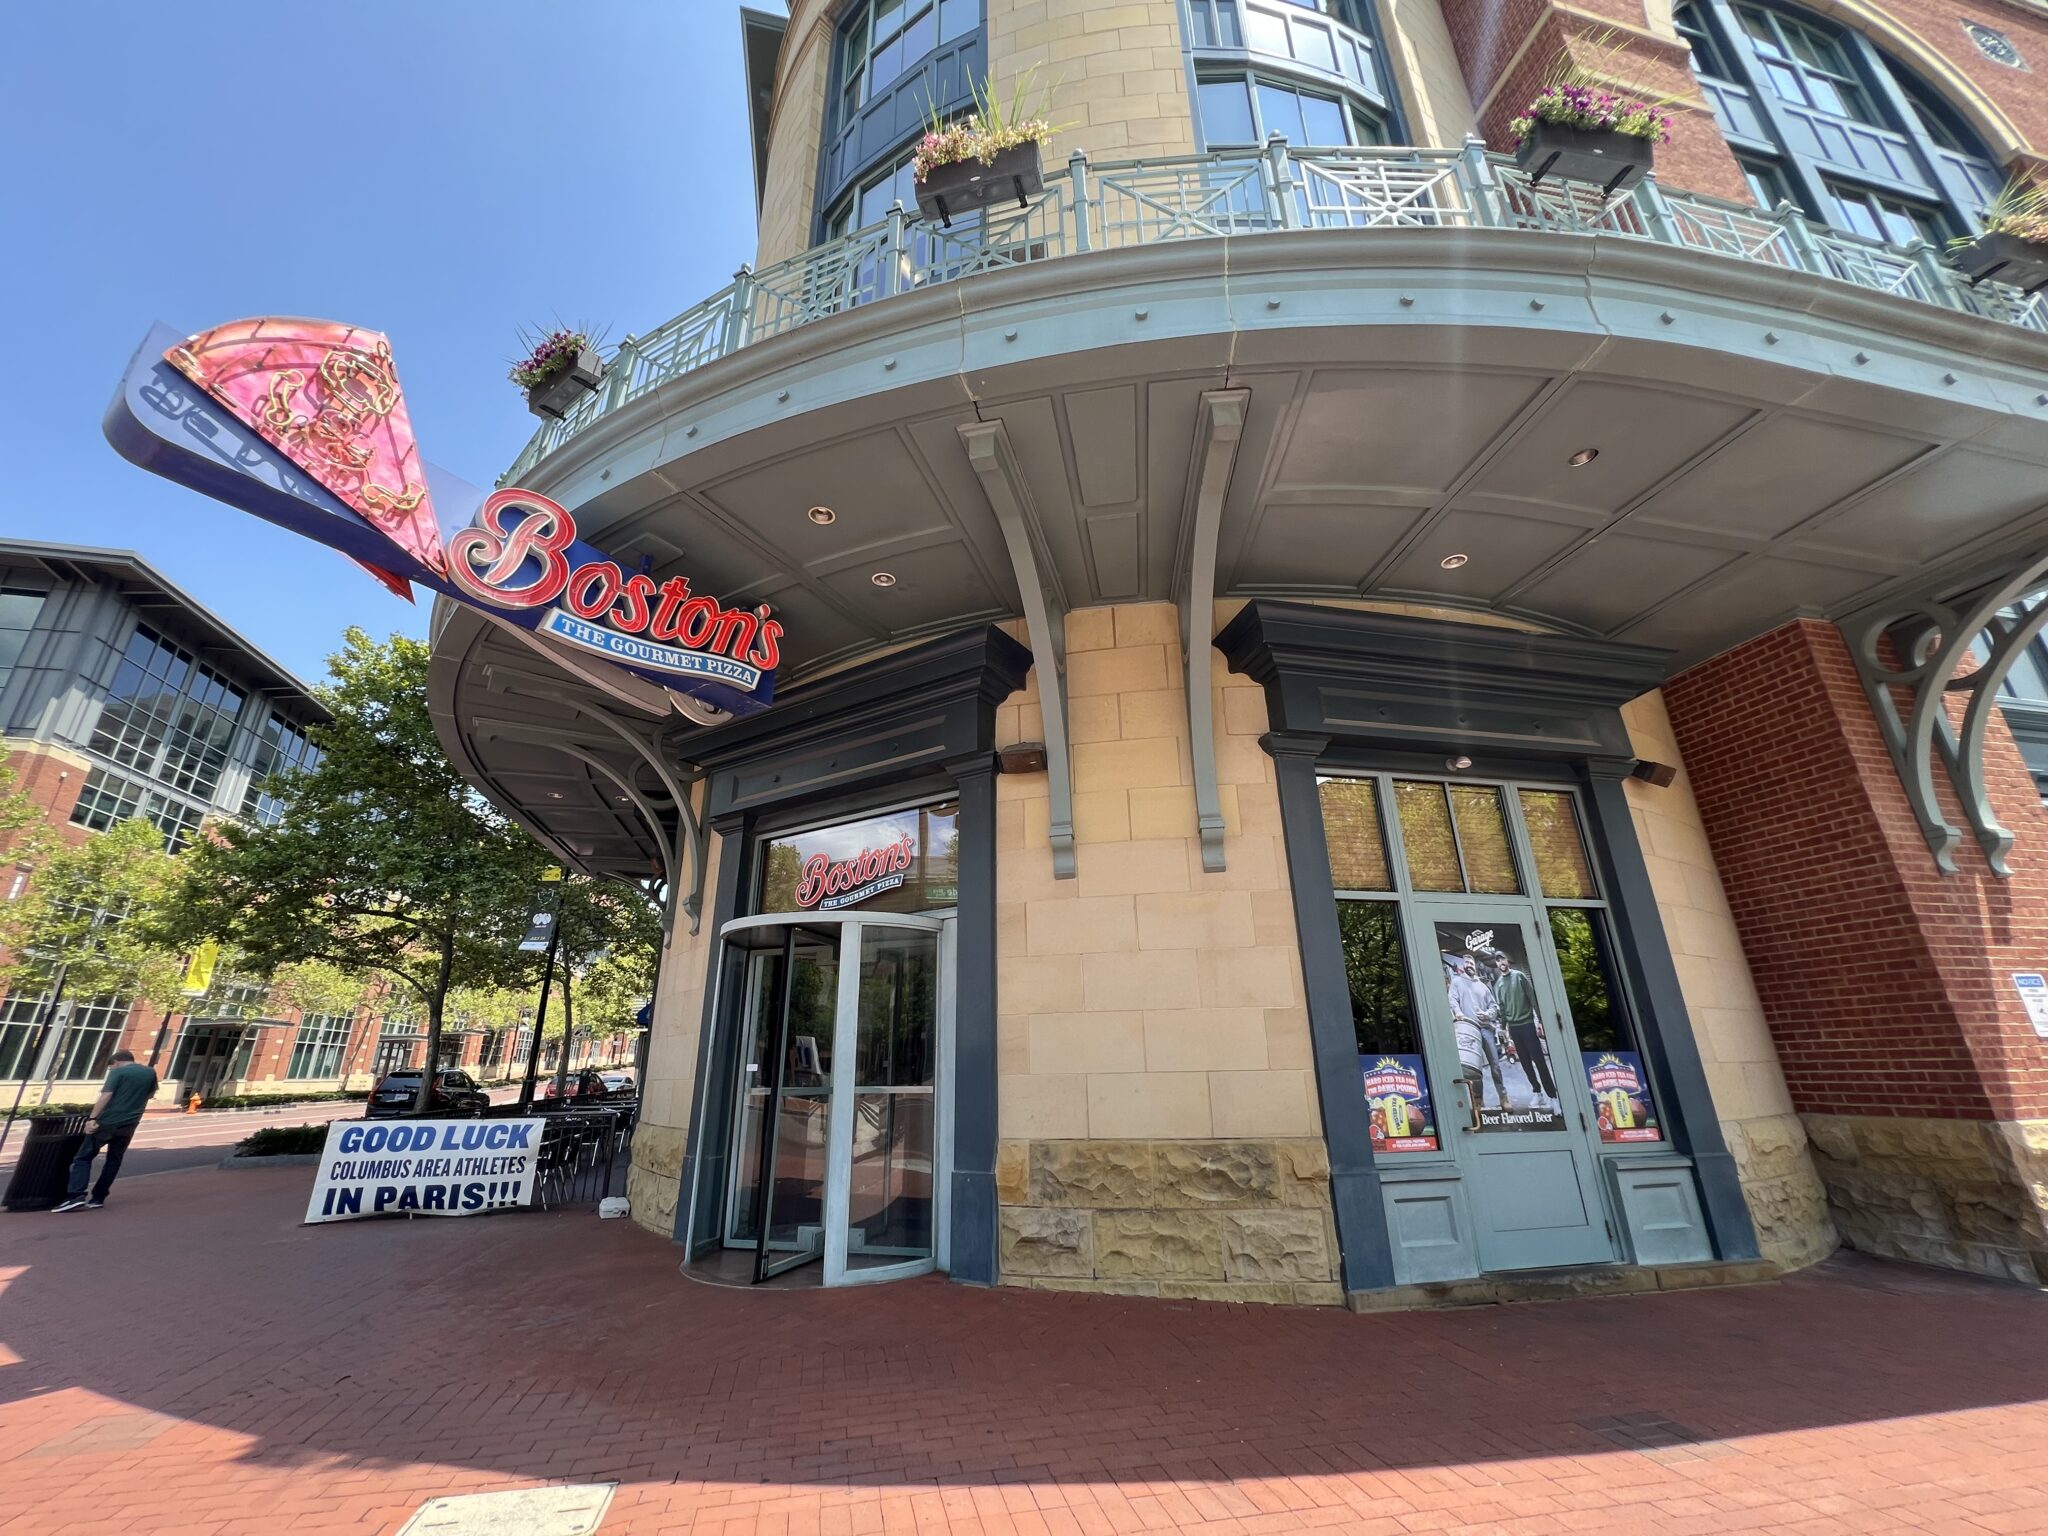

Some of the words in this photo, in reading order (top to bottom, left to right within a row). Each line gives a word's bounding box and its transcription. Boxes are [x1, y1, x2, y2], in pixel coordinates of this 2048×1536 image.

[450, 487, 784, 671] Boston's
[561, 619, 605, 646] THE
[610, 636, 703, 670] GOURMET
[706, 660, 753, 683] PIZZA
[795, 832, 914, 908] Boston's
[824, 899, 838, 908] THE
[840, 886, 875, 904] GOURMET
[877, 878, 900, 891] PIZZA
[1465, 929, 1495, 951] Garage
[1481, 1113, 1500, 1125] Beer
[1501, 1111, 1534, 1124] Flavored
[1534, 1111, 1553, 1123] Beer
[339, 1125, 437, 1154] GOOD
[440, 1123, 534, 1151] LUCK
[330, 1158, 412, 1181] COLUMBUS
[412, 1158, 450, 1178] AREA
[453, 1155, 527, 1177] ATHLETES
[321, 1187, 363, 1216] IN
[373, 1180, 522, 1212] PARIS!!!
